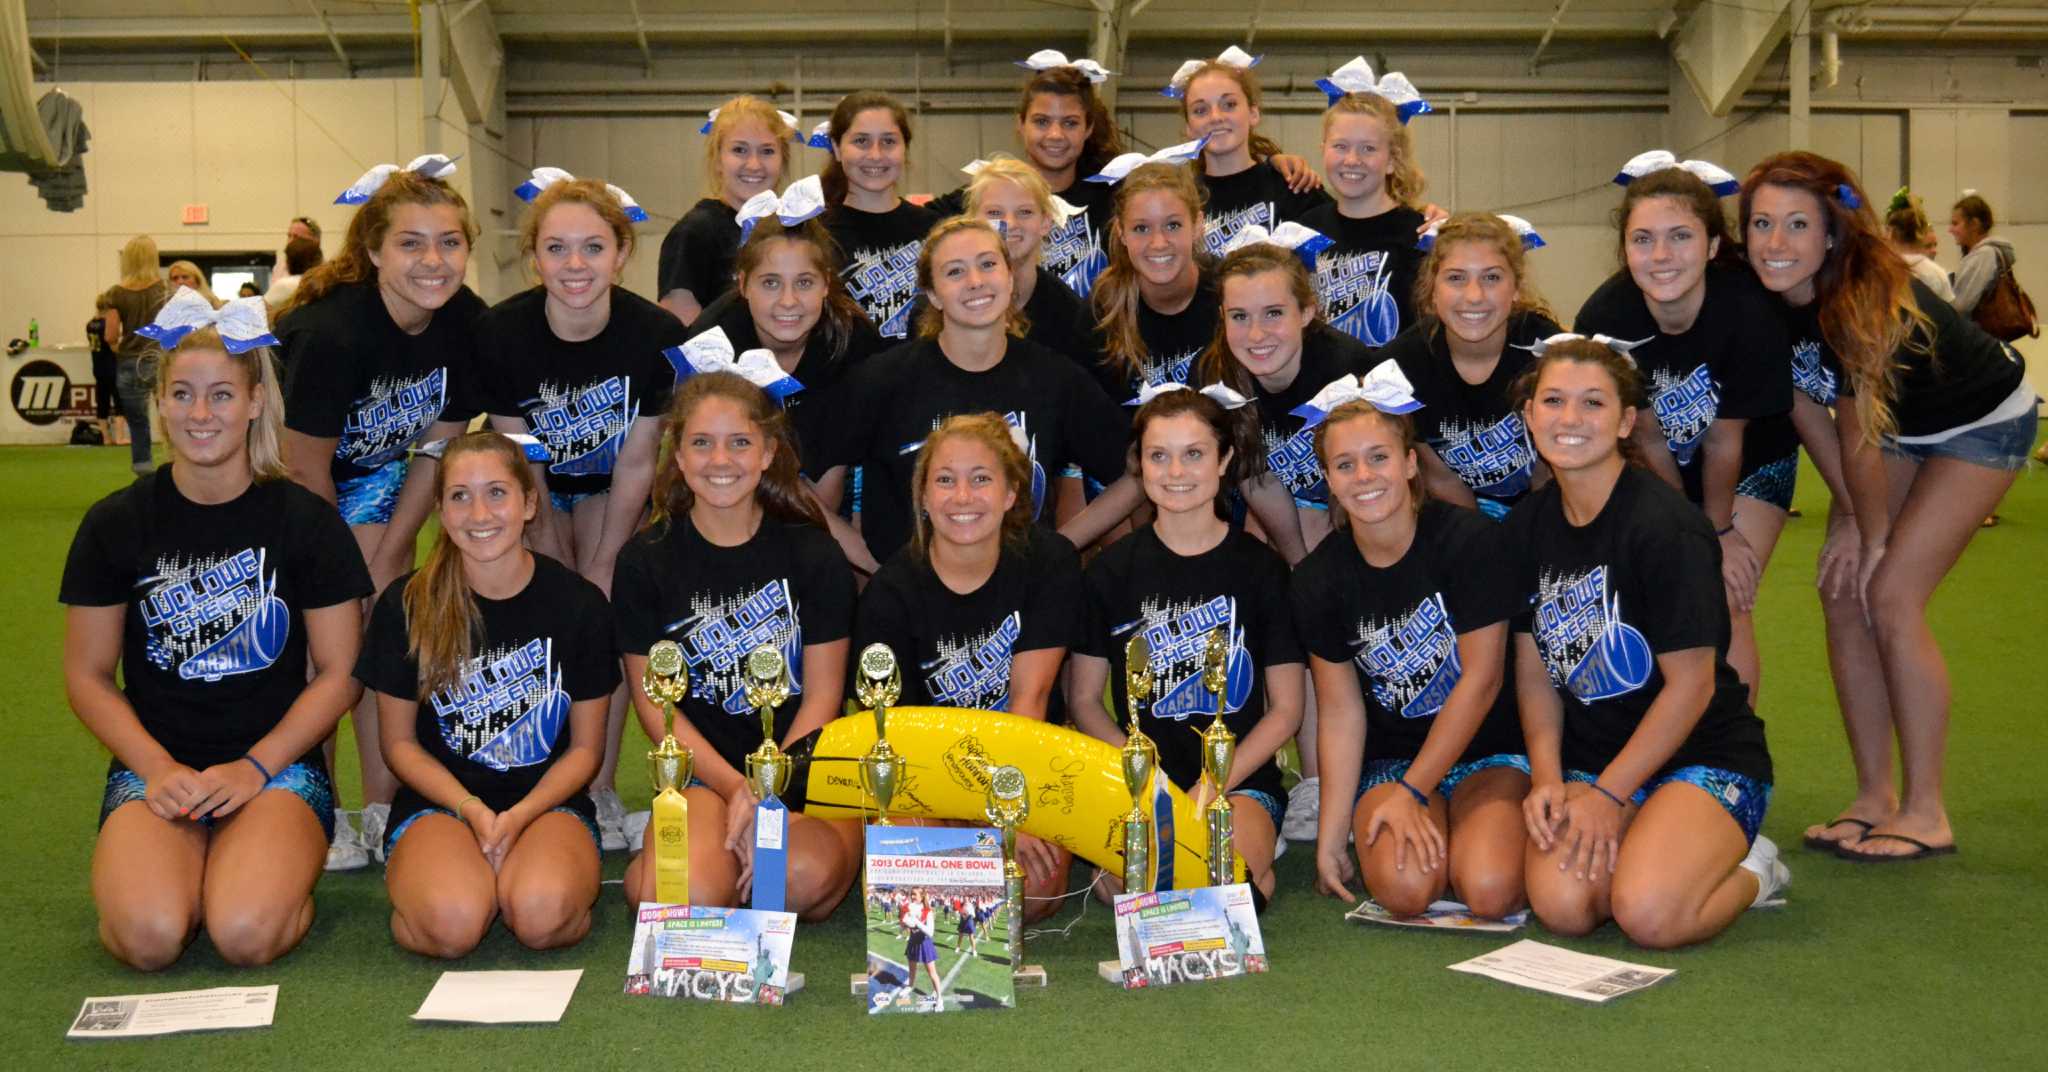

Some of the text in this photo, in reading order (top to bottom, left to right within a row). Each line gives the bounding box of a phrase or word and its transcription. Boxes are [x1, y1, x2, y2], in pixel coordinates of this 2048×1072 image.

[344, 368, 443, 433] LUDLOWE
[366, 401, 434, 441] CHEER
[547, 409, 619, 445] CHEER
[140, 548, 260, 628] LUDLOWE
[170, 584, 253, 636] CHEER
[678, 580, 787, 667] LUDLOWE
[710, 615, 784, 672] CHEER
[1546, 604, 1600, 651] CHEER
[186, 629, 251, 674] VARSITY
[925, 614, 1018, 704] LUDLOWE
[1150, 632, 1208, 672] CHEE
[430, 637, 546, 717] LUDLOWE
[463, 674, 541, 725] CHEER
[871, 858, 997, 870] 2013 CAPITAL ONE BOWL
[654, 967, 755, 1001] MACYS
[1146, 949, 1240, 984] MACYS
